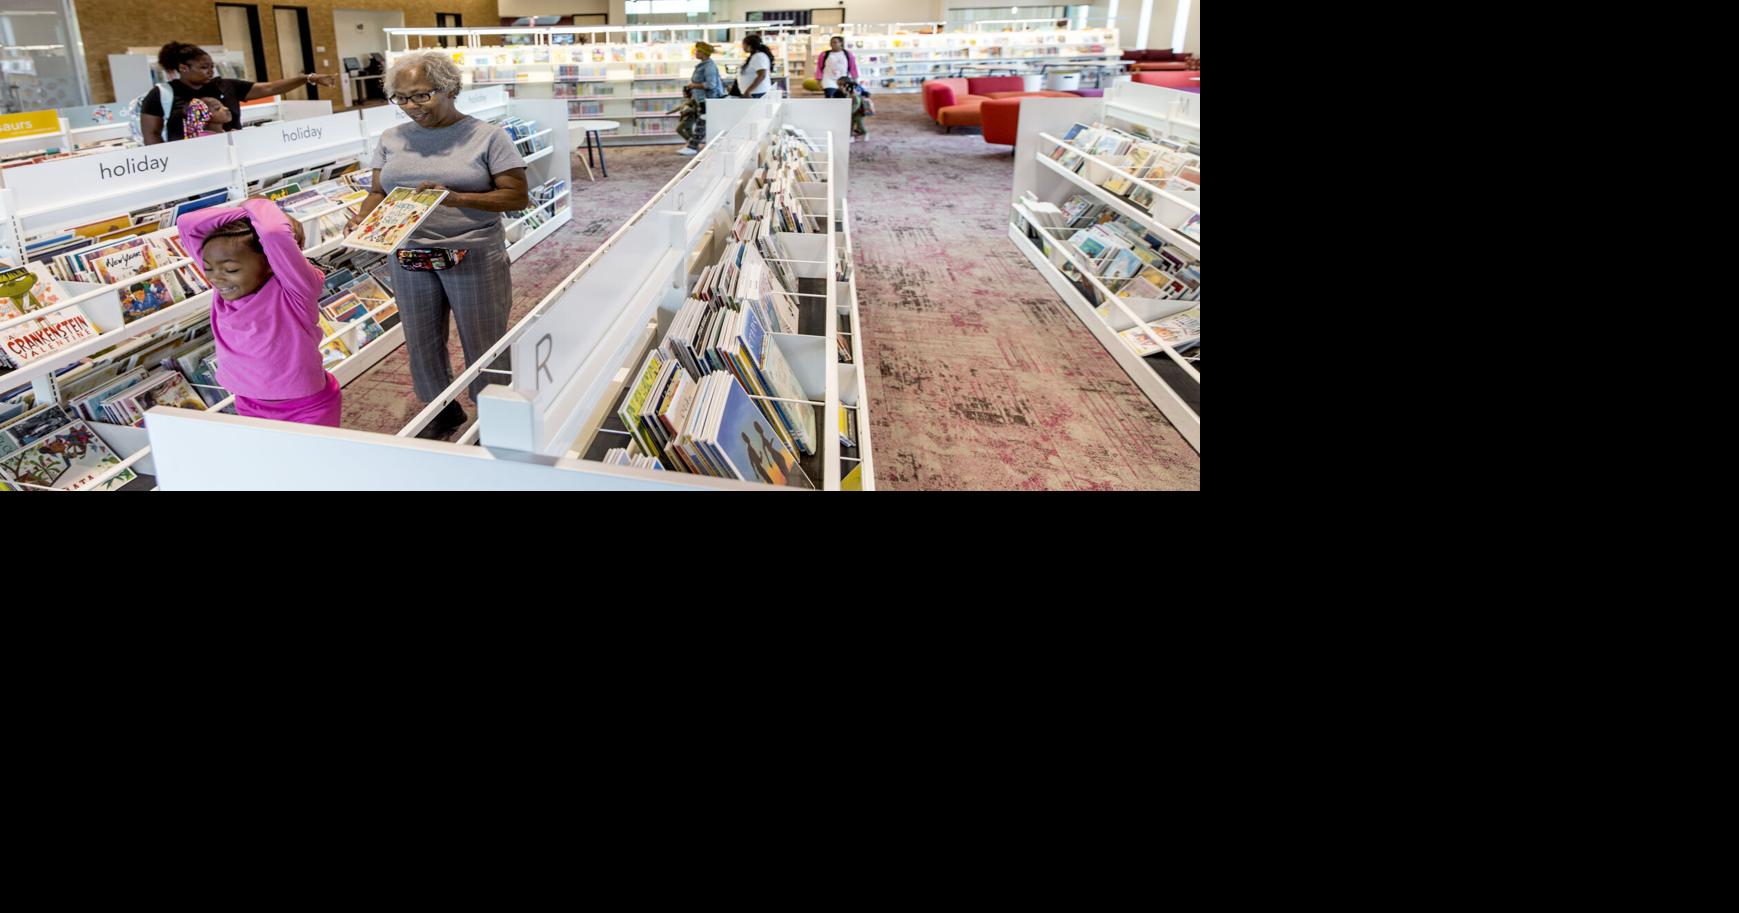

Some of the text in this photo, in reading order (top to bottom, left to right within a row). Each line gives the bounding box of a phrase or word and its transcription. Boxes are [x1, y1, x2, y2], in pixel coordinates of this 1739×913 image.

[282, 125, 322, 144] holiday
[100, 154, 169, 180] holiday
[7, 315, 89, 355] CRANKENSTEIN
[20, 329, 92, 360] VALENTINE
[535, 332, 553, 391] R
